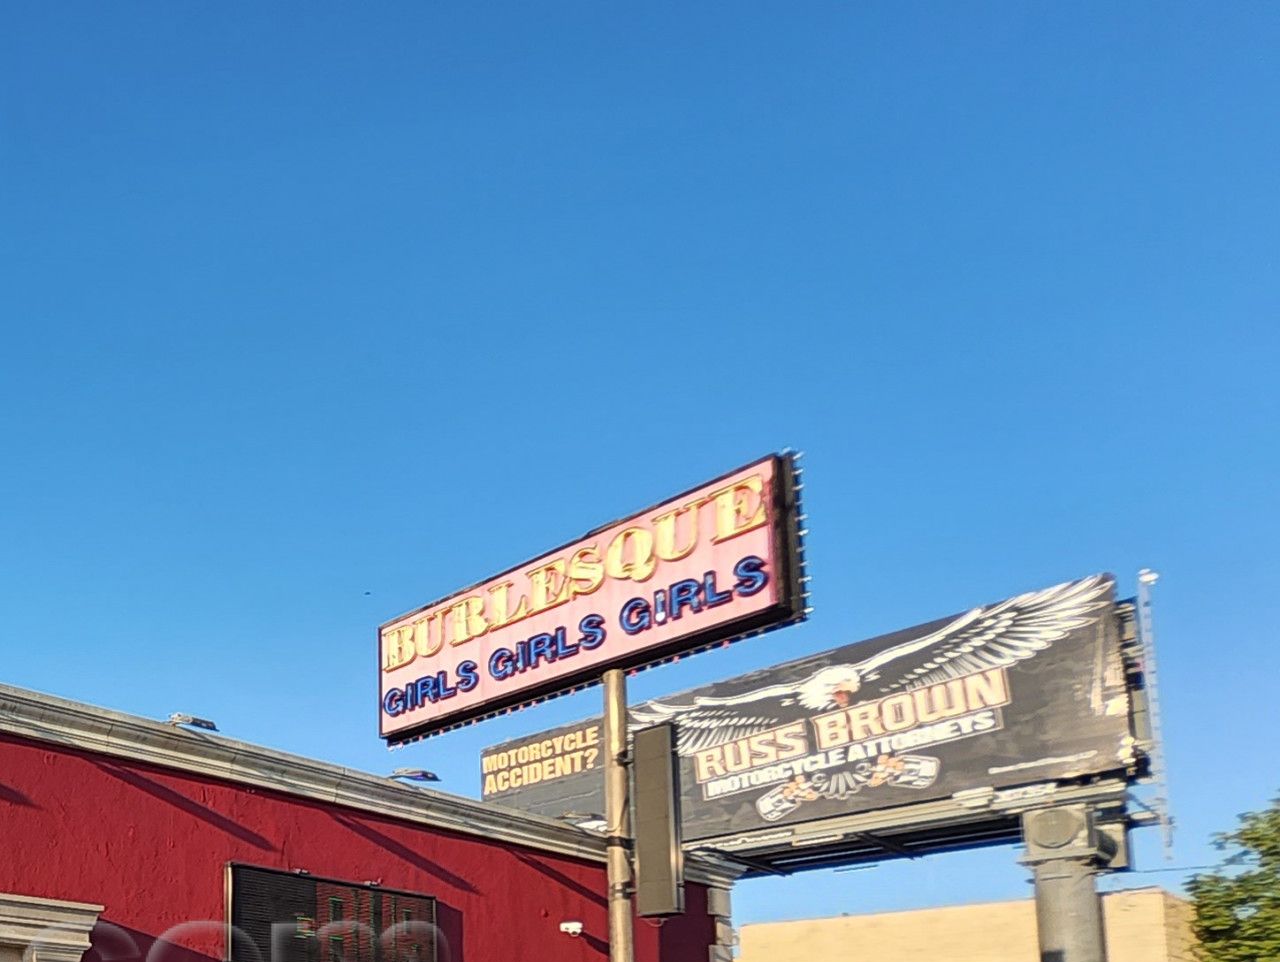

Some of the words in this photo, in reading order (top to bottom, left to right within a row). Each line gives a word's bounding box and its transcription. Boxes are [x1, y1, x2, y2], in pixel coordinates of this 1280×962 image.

[382, 473, 768, 673] BURLESQUE
[383, 660, 479, 717] GIRLS
[488, 614, 607, 681] GIRLS
[619, 555, 770, 635] GIRLS
[482, 726, 600, 774] MOTORCYCLE
[694, 720, 809, 783] RUSS
[815, 667, 1009, 750] BROWN
[483, 748, 599, 796] ACCIDENT?
[706, 749, 847, 796] MOTORCYCLE
